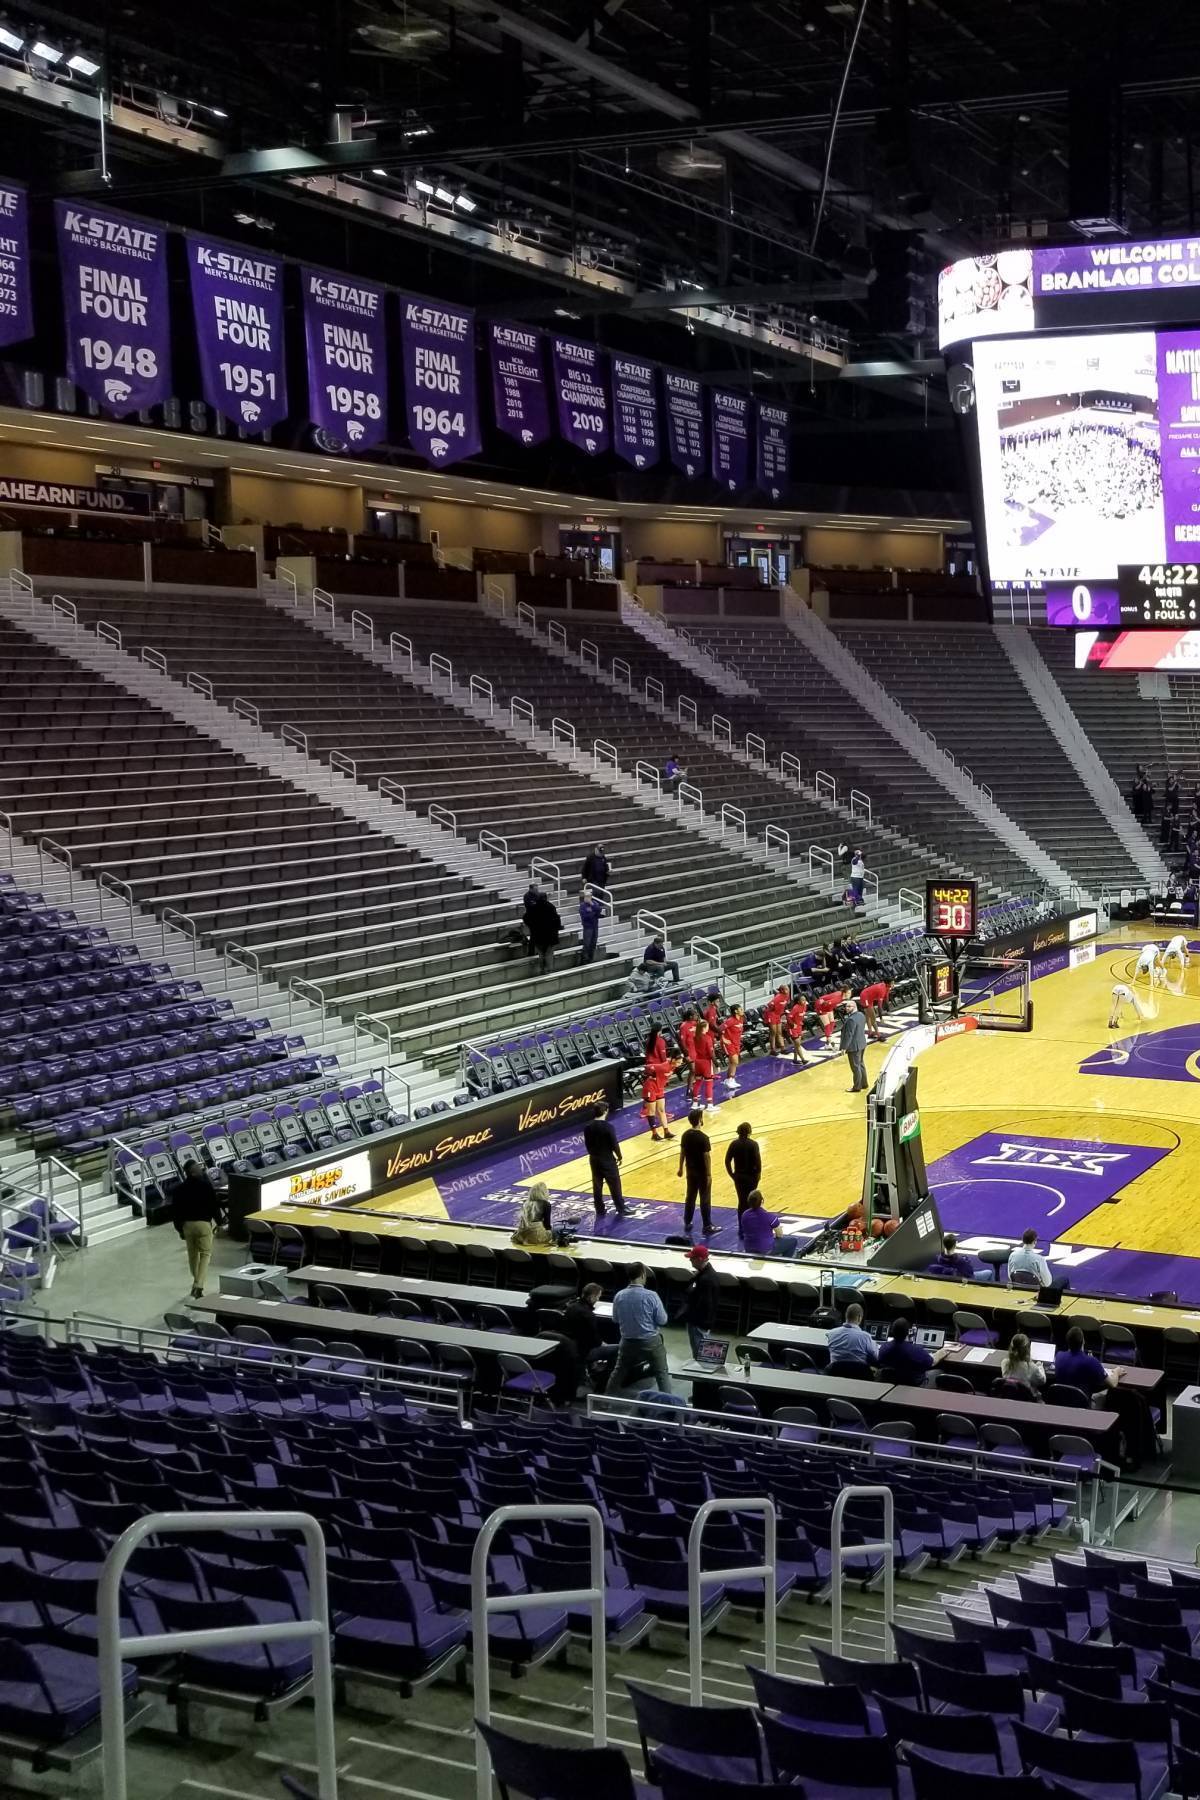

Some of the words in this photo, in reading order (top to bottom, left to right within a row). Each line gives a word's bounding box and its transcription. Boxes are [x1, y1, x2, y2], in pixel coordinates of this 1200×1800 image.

[64, 211, 158, 253] K-STATE
[71, 233, 98, 247] MEN'S
[100, 240, 153, 261] BASKETBALL
[1091, 243, 1183, 266] WELCOME
[197, 246, 276, 283] K-STATE
[79, 265, 148, 303] FINAL
[204, 267, 227, 280] MEN'S
[229, 272, 273, 291] BASKETBALL
[1041, 266, 1154, 292] BRAMLAGE
[310, 277, 379, 310] K-STATE
[315, 296, 335, 308] MEN'S
[336, 300, 375, 318] BASKETBALL
[80, 290, 147, 326] FOUR
[214, 296, 271, 330] FINAL
[406, 304, 468, 334] K-STATE
[216, 319, 271, 351] FOUR
[323, 323, 373, 354] FINAL
[410, 321, 428, 333] MEN'S
[429, 324, 464, 341] BASKETBALL
[493, 325, 537, 348] K-STATE
[80, 337, 158, 378] 1948
[324, 345, 373, 374] FOUR
[415, 347, 461, 375] FINAL
[555, 340, 595, 361] K-STATE
[220, 362, 275, 400] 1951
[415, 367, 461, 395] FOUR
[498, 360, 518, 373] ELITE
[518, 364, 539, 378] EIGHT
[567, 368, 581, 381] BIG
[582, 372, 592, 383] 12
[615, 359, 652, 380] K-STATE
[561, 379, 605, 397] CONFERENCE
[666, 374, 700, 393] K-STATE
[326, 385, 381, 419] 1958
[561, 388, 606, 409] CHAMPIONS
[412, 405, 466, 437] 1964
[571, 411, 604, 432] 2019
[1138, 564, 1199, 585] 44:22
[1071, 584, 1092, 621] 0
[1143, 600, 1151, 609] 4
[1160, 600, 1179, 609] TOL
[1189, 599, 1196, 608] 4
[1155, 611, 1186, 620] FOULS
[934, 889, 969, 904] 44:22
[938, 905, 965, 930] 30
[518, 1100, 557, 1131] VISION
[559, 1089, 607, 1116] SOURCE
[386, 1143, 433, 1178] VISION
[435, 1128, 493, 1160] SOURCE
[290, 1167, 343, 1195] Briggs
[324, 1184, 357, 1203] SAVINGS
